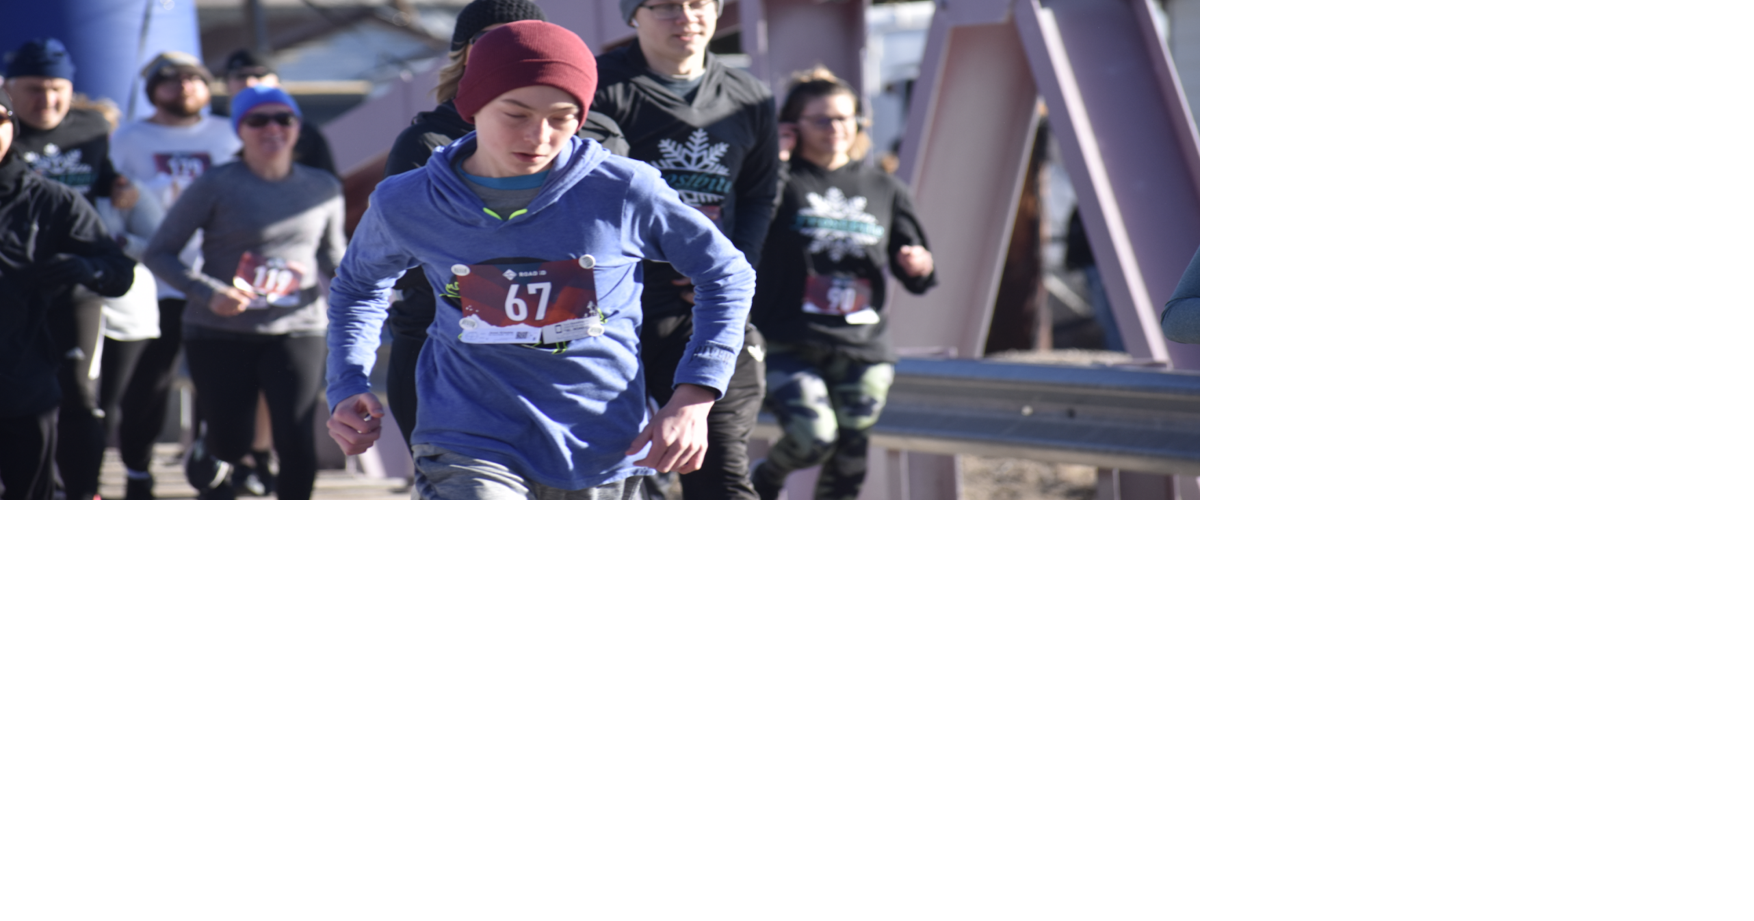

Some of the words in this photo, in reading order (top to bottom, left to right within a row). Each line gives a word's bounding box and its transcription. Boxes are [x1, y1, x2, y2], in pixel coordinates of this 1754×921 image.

[253, 265, 293, 293] 119
[505, 282, 552, 321] 67
[827, 287, 856, 312] 90
